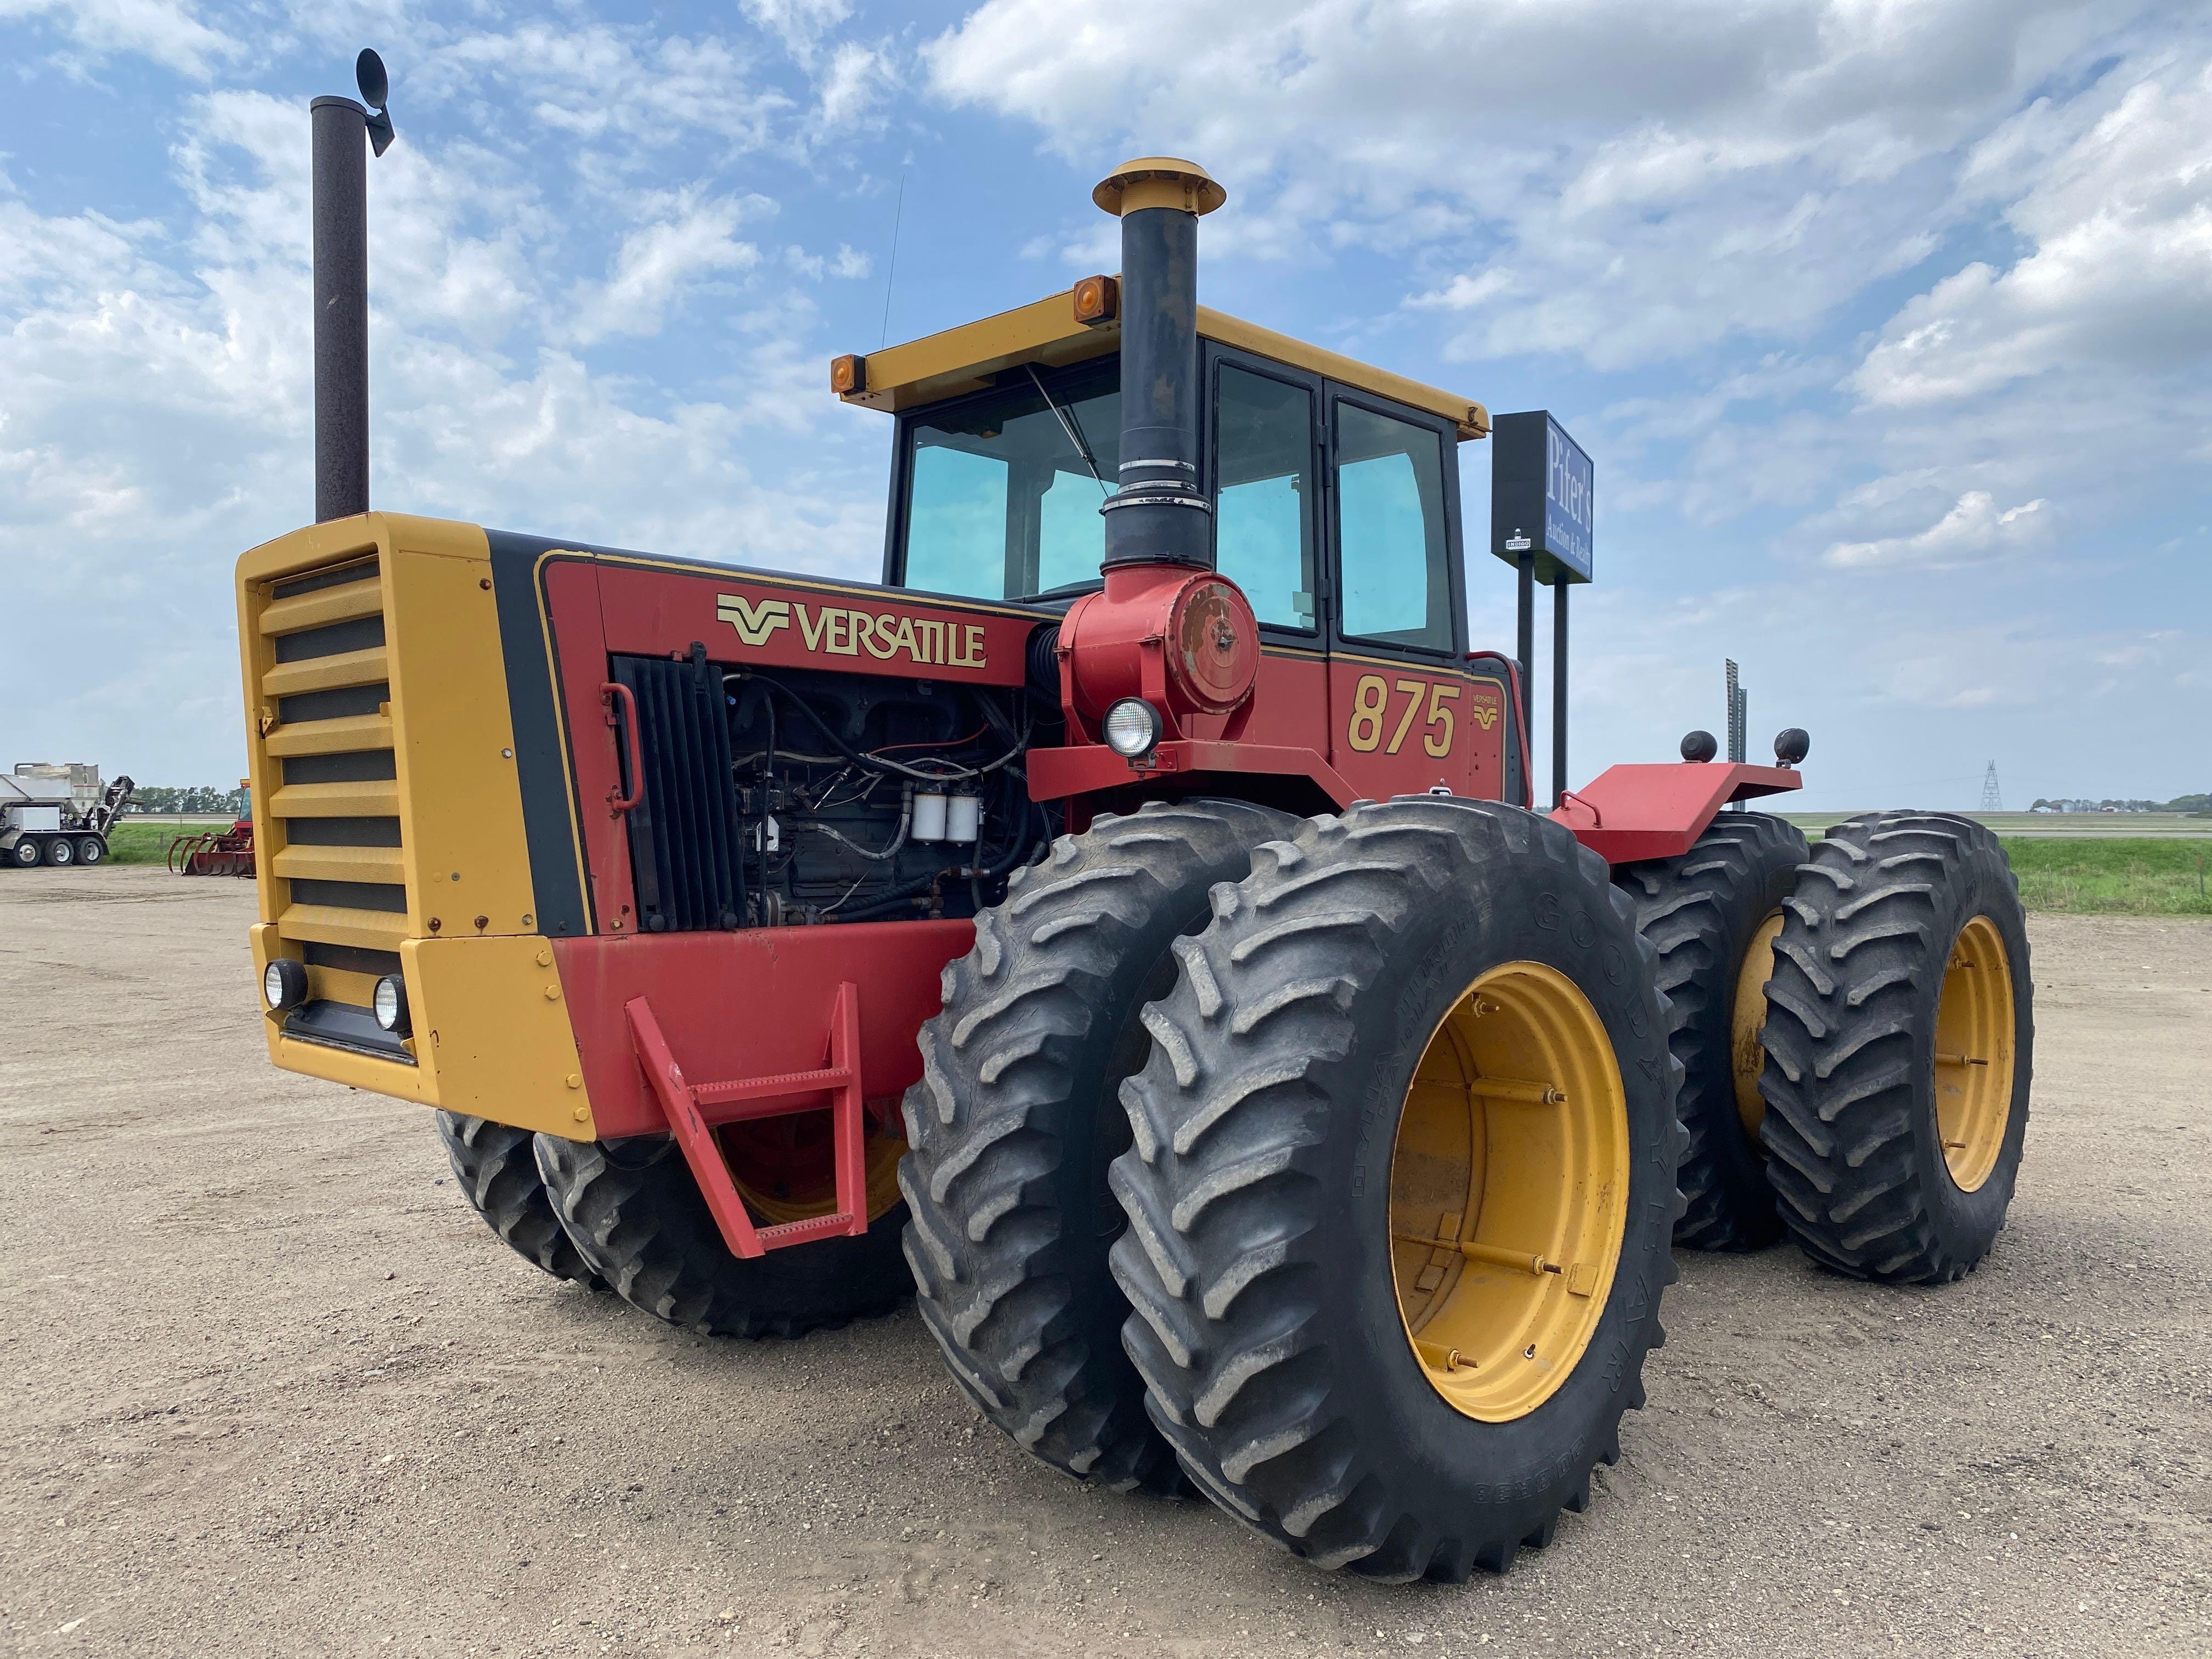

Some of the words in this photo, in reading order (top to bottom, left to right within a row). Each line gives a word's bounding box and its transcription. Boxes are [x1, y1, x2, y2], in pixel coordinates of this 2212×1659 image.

[1547, 426, 1592, 534] Pifer's
[1547, 514, 1570, 551] Auction
[1571, 532, 1576, 556] &
[1577, 535, 1590, 575] Realty
[792, 602, 987, 669] VERSATILE
[1348, 674, 1462, 759] 875
[1473, 694, 1498, 705] VERSATILE
